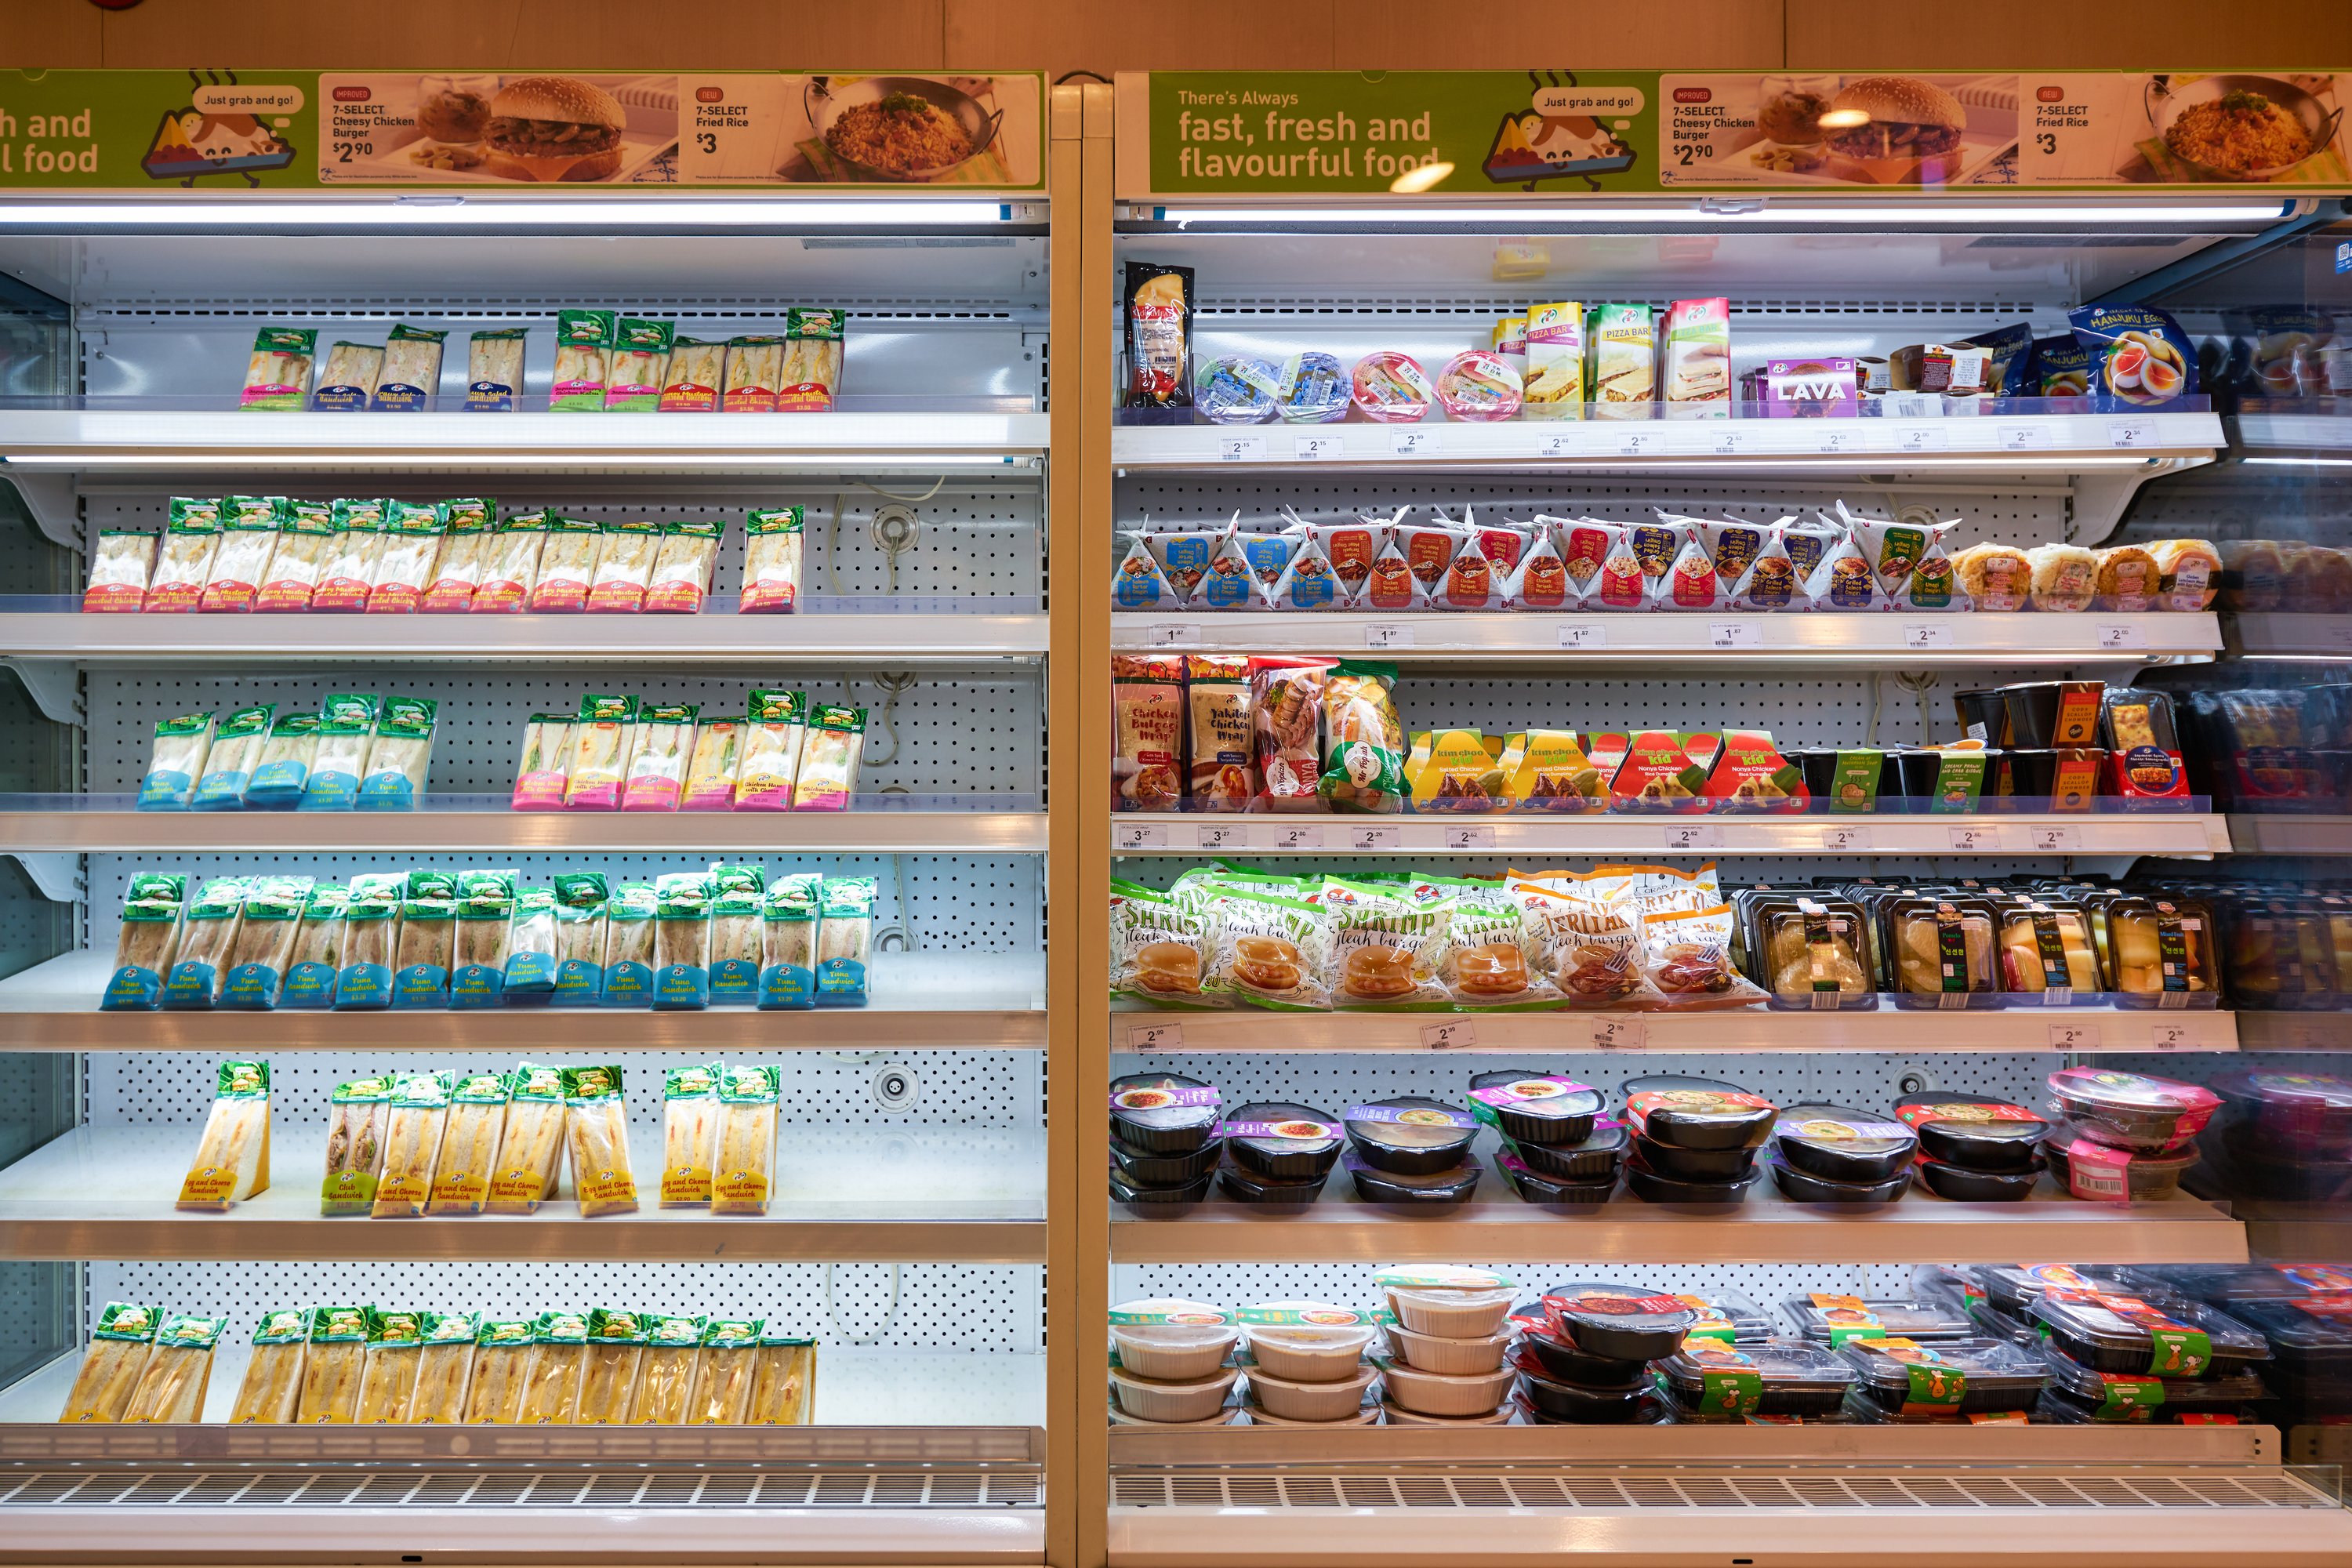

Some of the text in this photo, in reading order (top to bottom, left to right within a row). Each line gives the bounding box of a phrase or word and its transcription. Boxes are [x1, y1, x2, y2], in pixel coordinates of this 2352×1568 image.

[204, 95, 293, 108] Just grab and go!
[1241, 91, 1298, 108] Always
[1544, 96, 1635, 111] Just grab and go!
[332, 105, 385, 114] 7-SELECT
[696, 107, 748, 116] 7-SELECT
[1673, 107, 1725, 116] 7-SELECT
[2036, 106, 2089, 115] 7-SELECT
[28, 108, 91, 137] and
[332, 117, 415, 128] Cheesy Chicken
[696, 118, 749, 127] Fried Rice
[1673, 118, 1755, 129] Cheesy Chicken
[2036, 118, 2089, 127] Fried Rice
[332, 129, 369, 139] Burger
[1179, 111, 1432, 147] fast, fresh and
[1673, 130, 1709, 141] Burger
[24, 143, 98, 172] food
[1179, 147, 1353, 177] flavourful
[2090, 314, 2141, 328] HANJUKU
[1550, 325, 1568, 336] BAR
[1606, 329, 1630, 338] PIZZA
[1777, 381, 1846, 401] LAVA
[1132, 708, 1178, 720] Chicken
[1210, 708, 1250, 720] Yakitori
[1131, 719, 1178, 733] Bulgogi
[1210, 719, 1250, 730] Chicken
[1139, 730, 1171, 742] Wrap
[1217, 730, 1246, 742] Wrap
[1357, 746, 1368, 782] Mr Popiah
[1450, 754, 1474, 766] kid
[1648, 753, 1672, 765] kid
[1125, 906, 1210, 939] SHRIMP
[1338, 907, 1436, 936] SHRIMP
[1334, 927, 1374, 949] steak
[343, 984, 377, 993] Sandwich
[210, 1178, 230, 1187] Cheese
[188, 1186, 219, 1195] Sandwich
[328, 1191, 363, 1200] Sandwich
